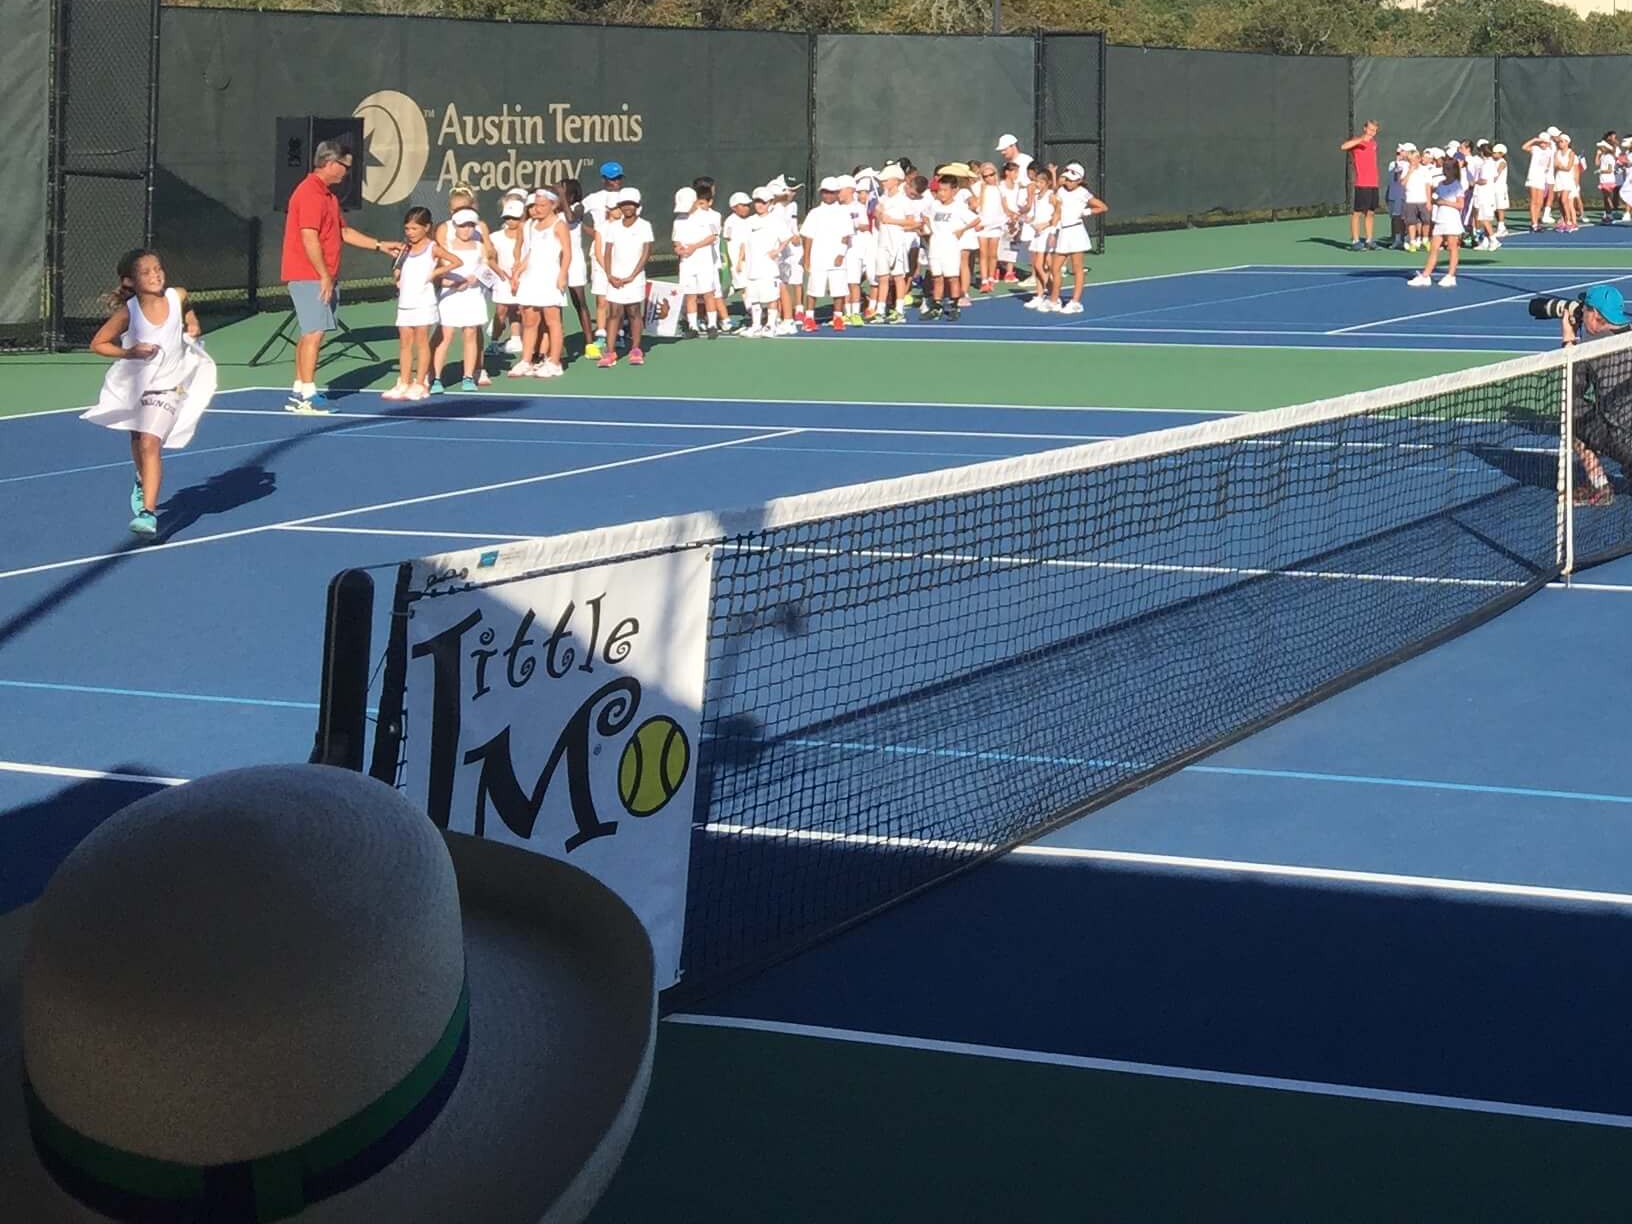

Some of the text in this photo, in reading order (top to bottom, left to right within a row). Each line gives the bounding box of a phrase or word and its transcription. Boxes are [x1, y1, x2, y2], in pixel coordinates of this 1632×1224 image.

[437, 102, 643, 146] Austin Tennis
[436, 149, 583, 192] Academy
